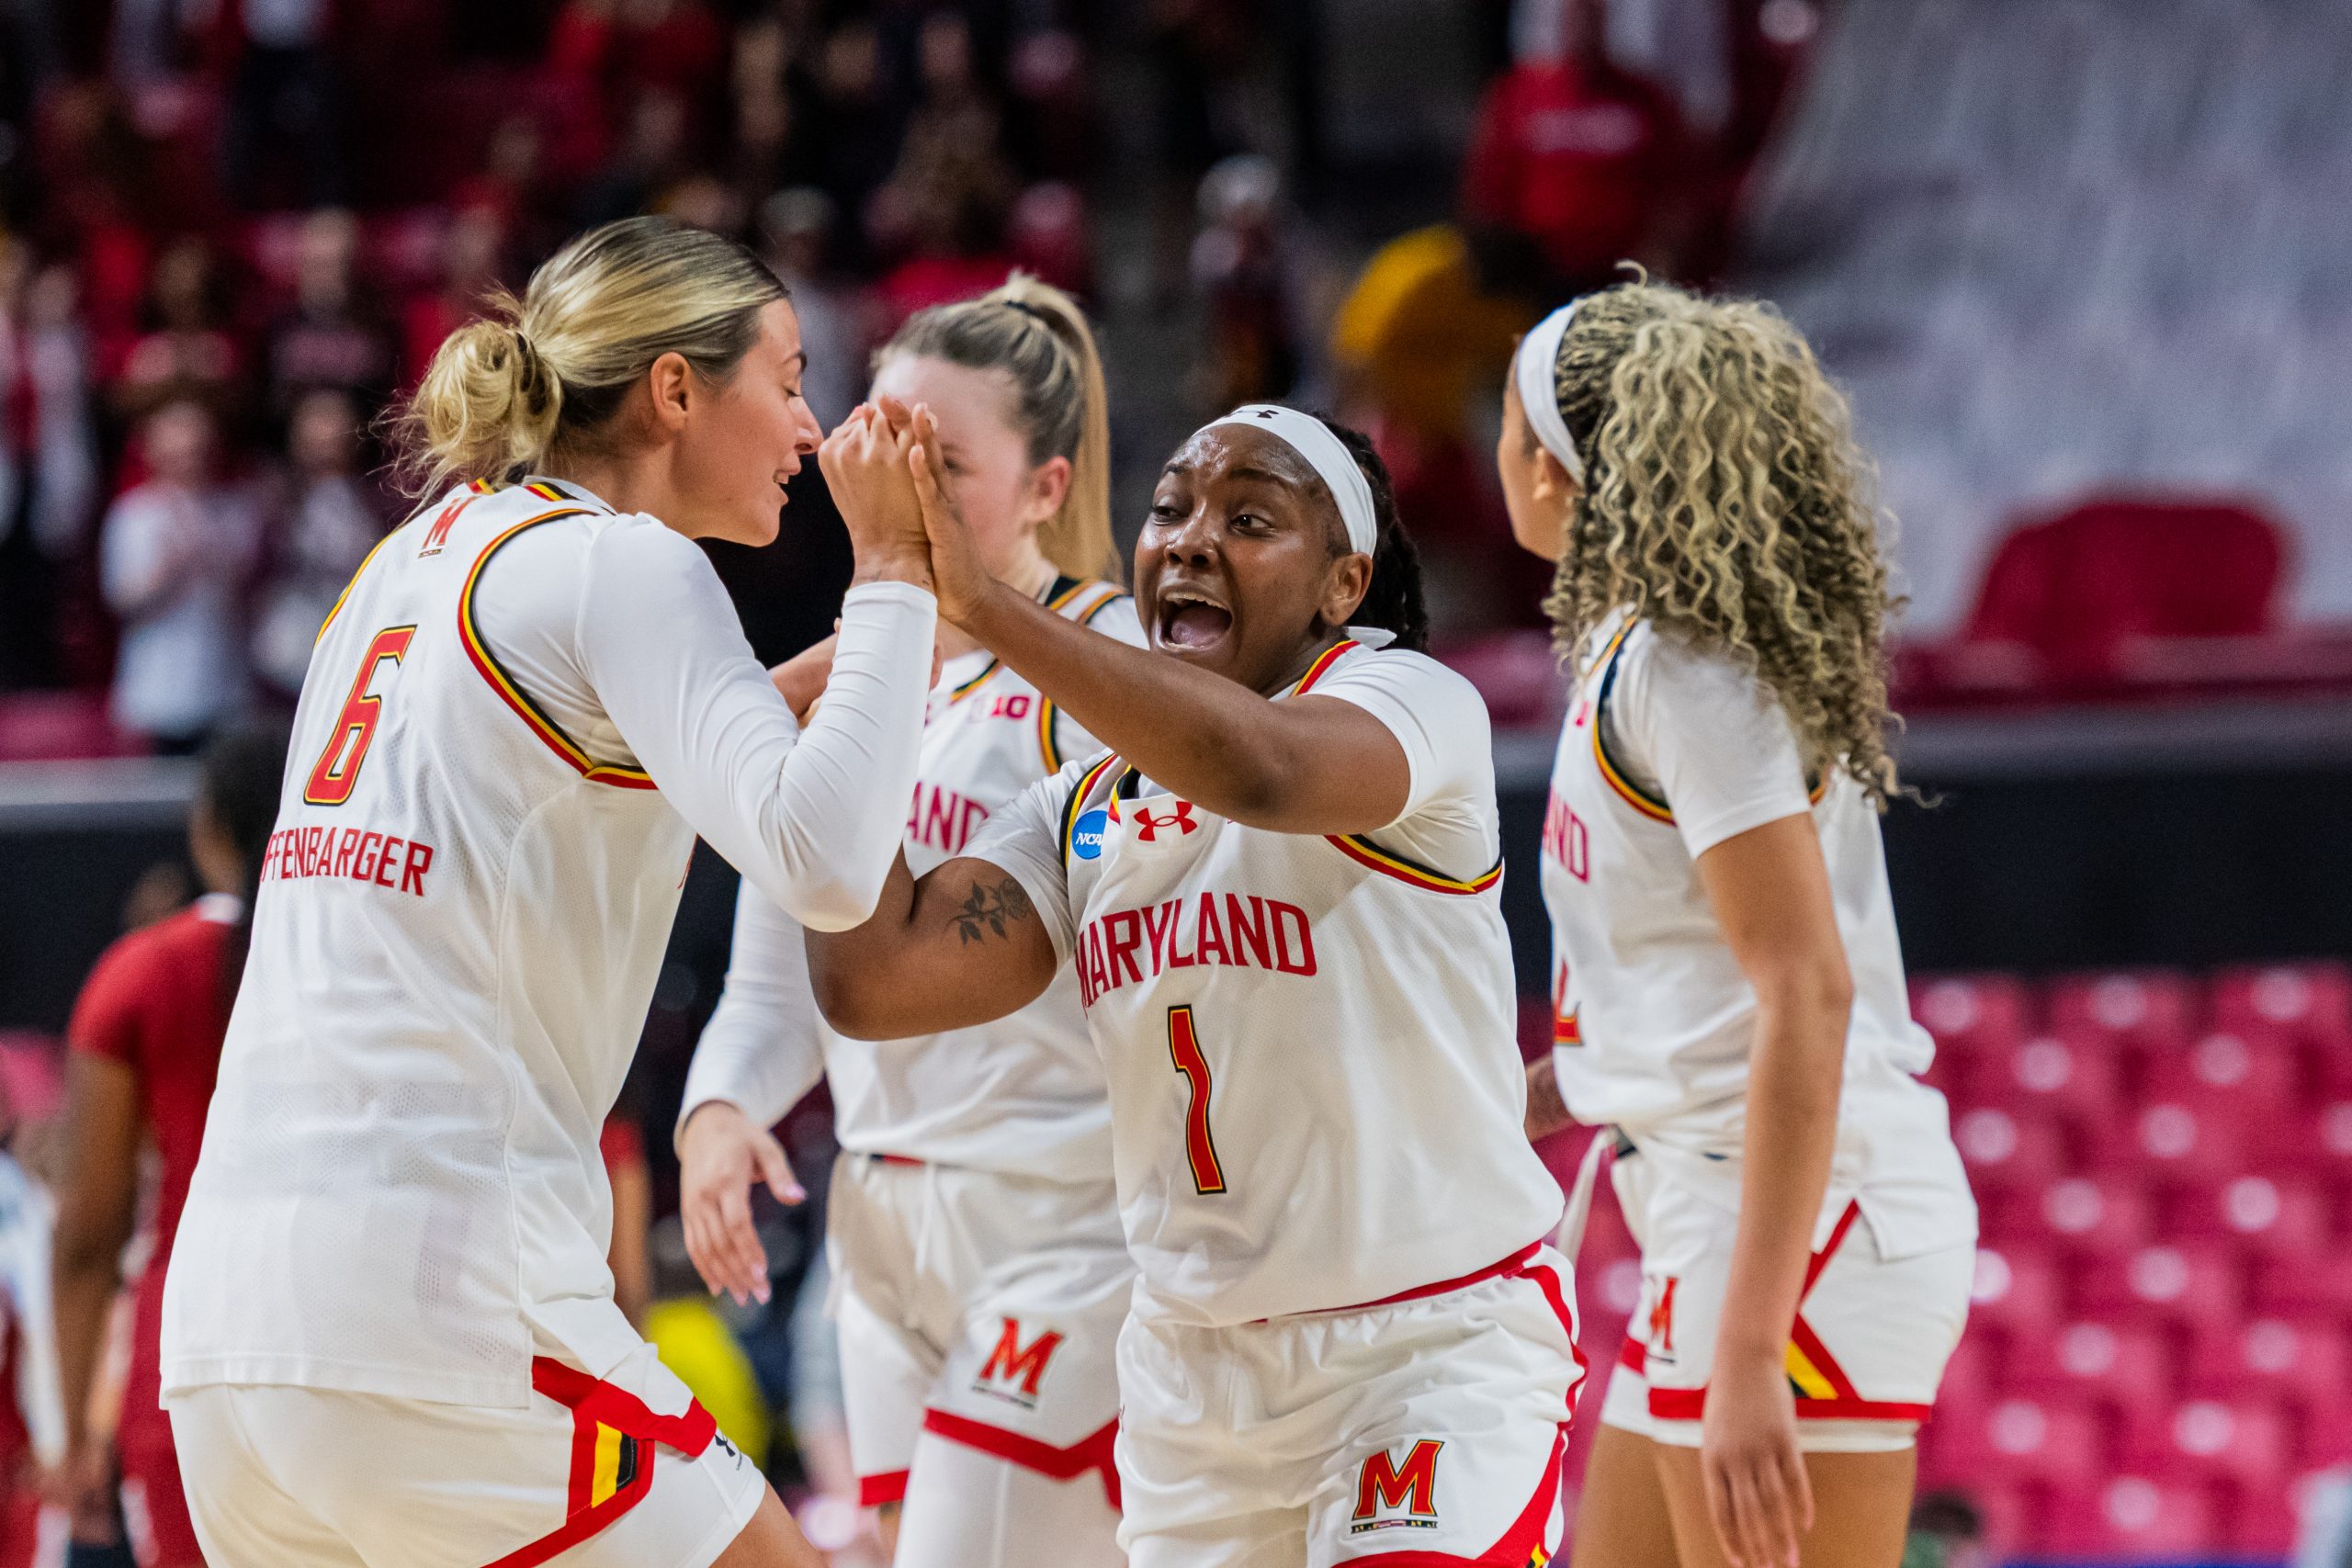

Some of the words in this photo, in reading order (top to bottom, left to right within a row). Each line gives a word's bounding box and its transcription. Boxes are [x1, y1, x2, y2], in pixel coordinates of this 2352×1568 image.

[422, 496, 478, 549] M
[303, 624, 418, 806] 6
[260, 827, 433, 897] FFENBARGER
[1075, 831, 1103, 846] NCA
[1075, 892, 1317, 1016] MARYLAND
[1168, 1004, 1227, 1195] 1
[978, 1317, 1064, 1397] M
[1351, 1438, 1445, 1520] M
